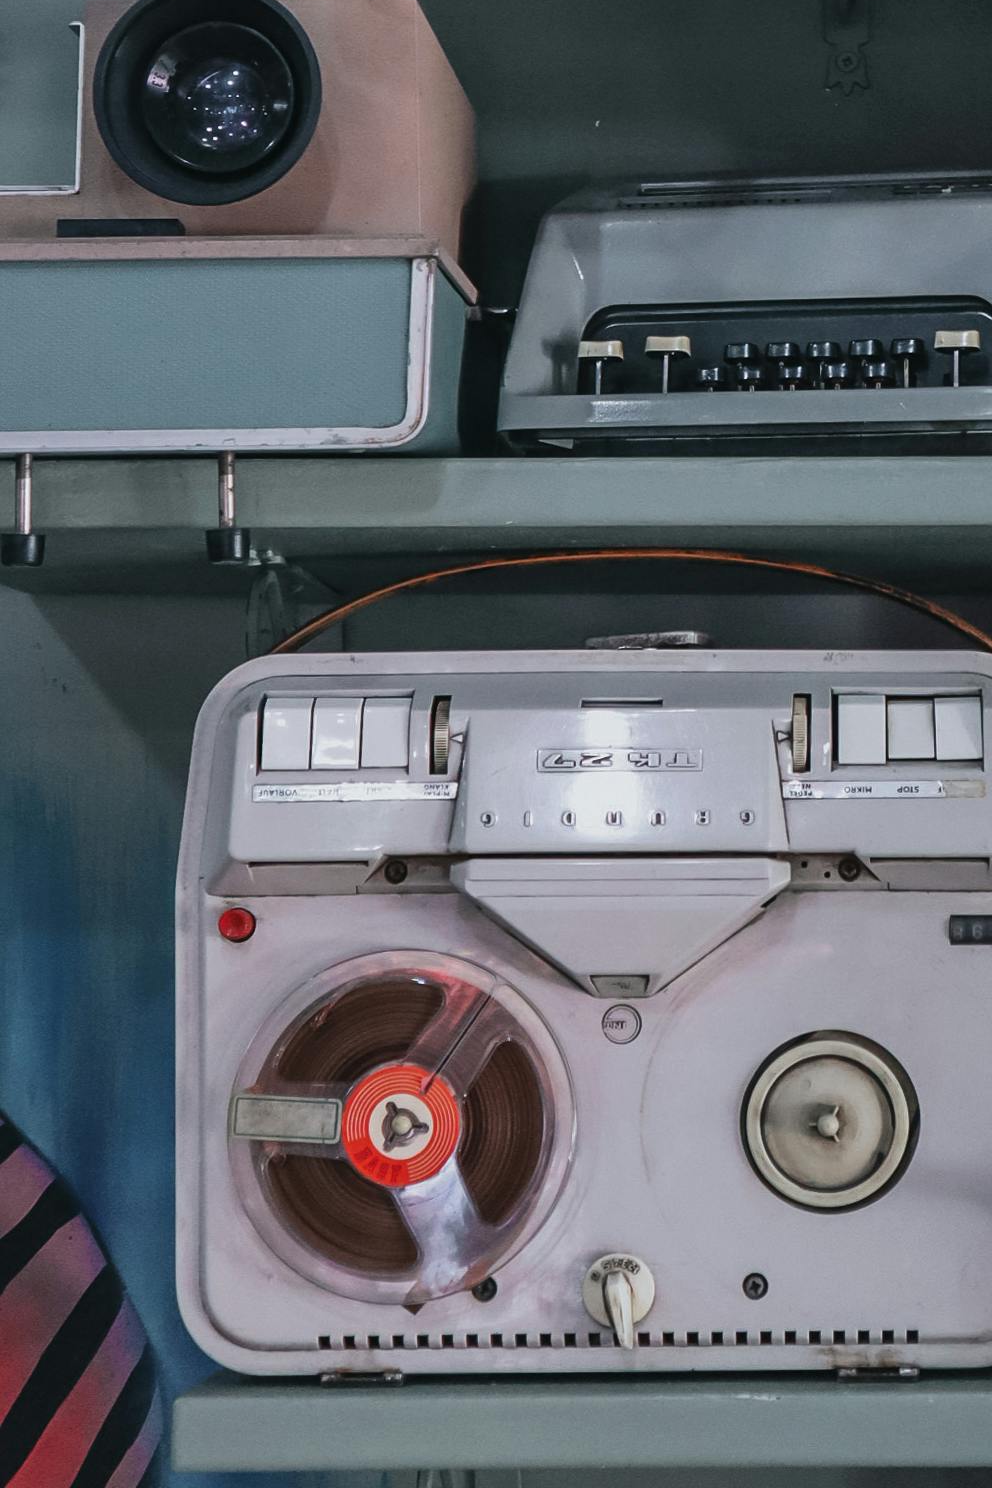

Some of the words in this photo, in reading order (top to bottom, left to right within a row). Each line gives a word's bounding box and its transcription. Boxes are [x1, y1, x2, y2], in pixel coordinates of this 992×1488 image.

[541, 751, 614, 769] 27
[627, 751, 700, 769] TK
[258, 788, 298, 798] VORLAUF
[843, 785, 873, 794] MIKRO
[896, 785, 920, 794] STOP
[479, 809, 757, 828] GRUNDIG
